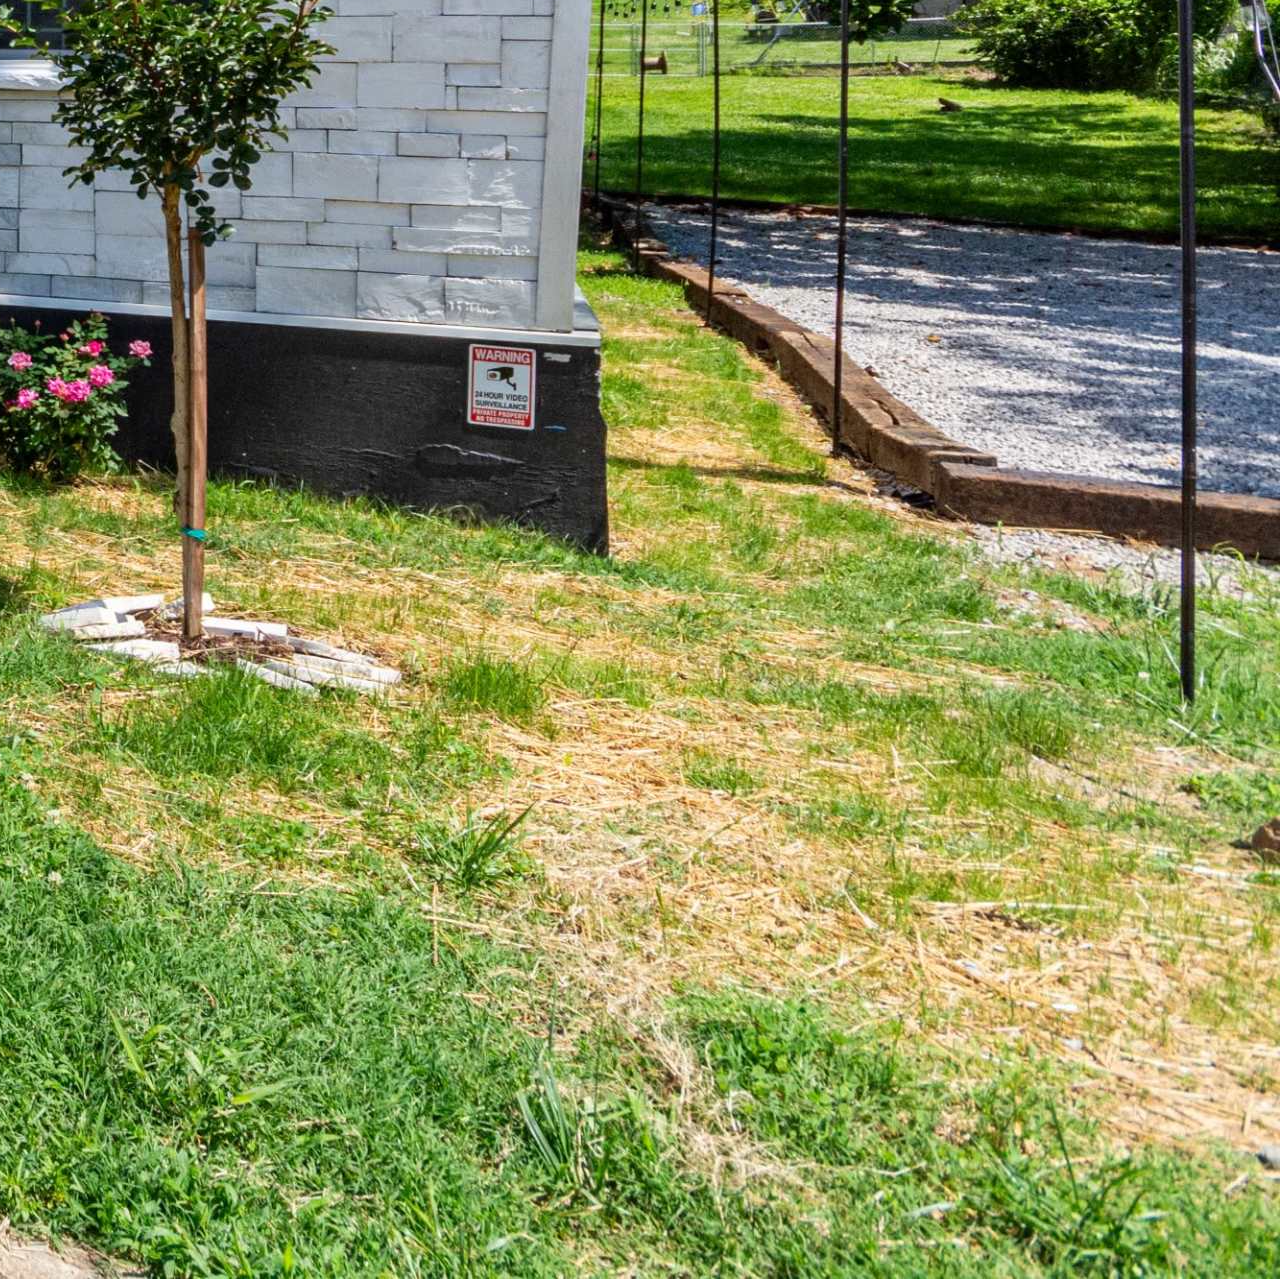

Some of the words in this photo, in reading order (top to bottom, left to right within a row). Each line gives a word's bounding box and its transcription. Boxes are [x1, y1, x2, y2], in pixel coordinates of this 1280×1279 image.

[474, 348, 531, 364] WARNING
[484, 391, 504, 400] HOUR
[506, 393, 528, 402] VIDEO
[475, 399, 527, 410] SURVEILLANCE
